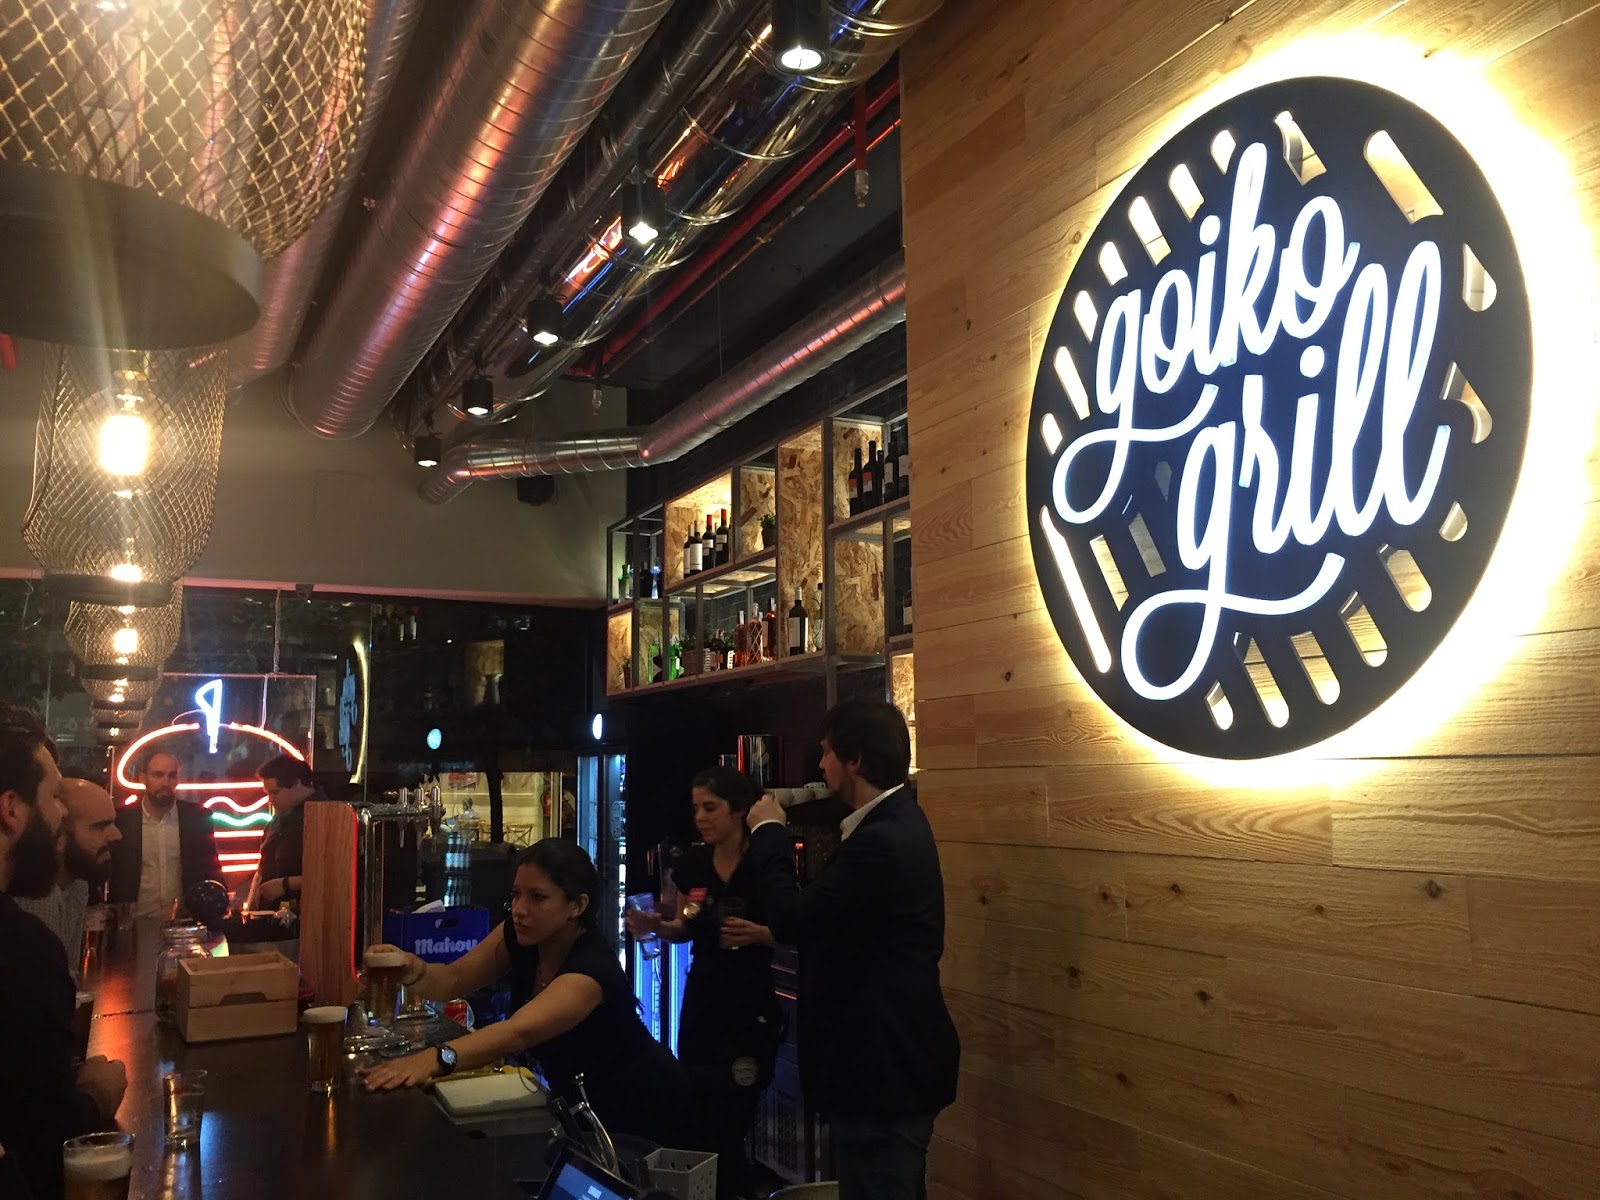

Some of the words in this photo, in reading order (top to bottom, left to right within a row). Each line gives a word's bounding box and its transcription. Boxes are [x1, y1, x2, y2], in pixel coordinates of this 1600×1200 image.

[1053, 142, 1360, 524] goiko
[1121, 241, 1451, 701] grill
[414, 936, 478, 955] Mahou
